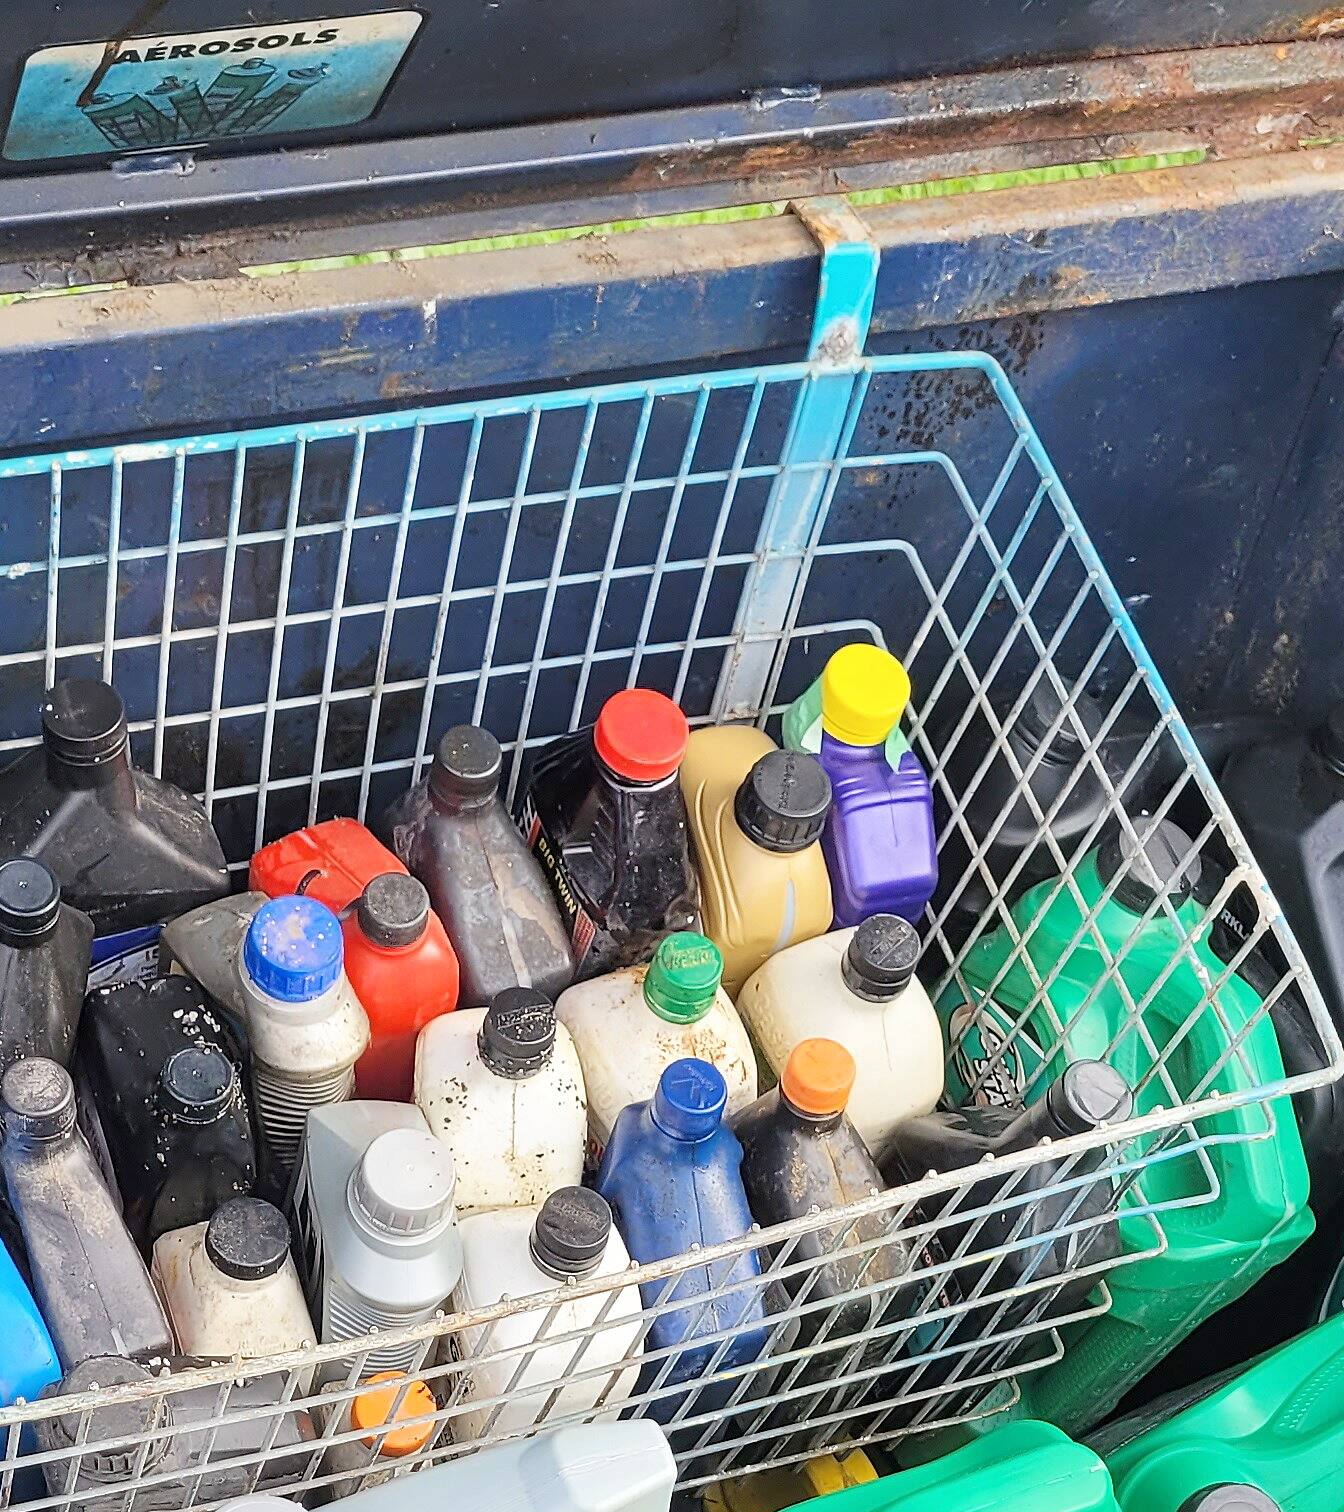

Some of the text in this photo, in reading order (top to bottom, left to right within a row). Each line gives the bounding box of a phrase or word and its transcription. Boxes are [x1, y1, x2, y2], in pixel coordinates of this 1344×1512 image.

[112, 28, 340, 65] AÉROSOLS
[539, 837, 577, 915] BIG TWIN
